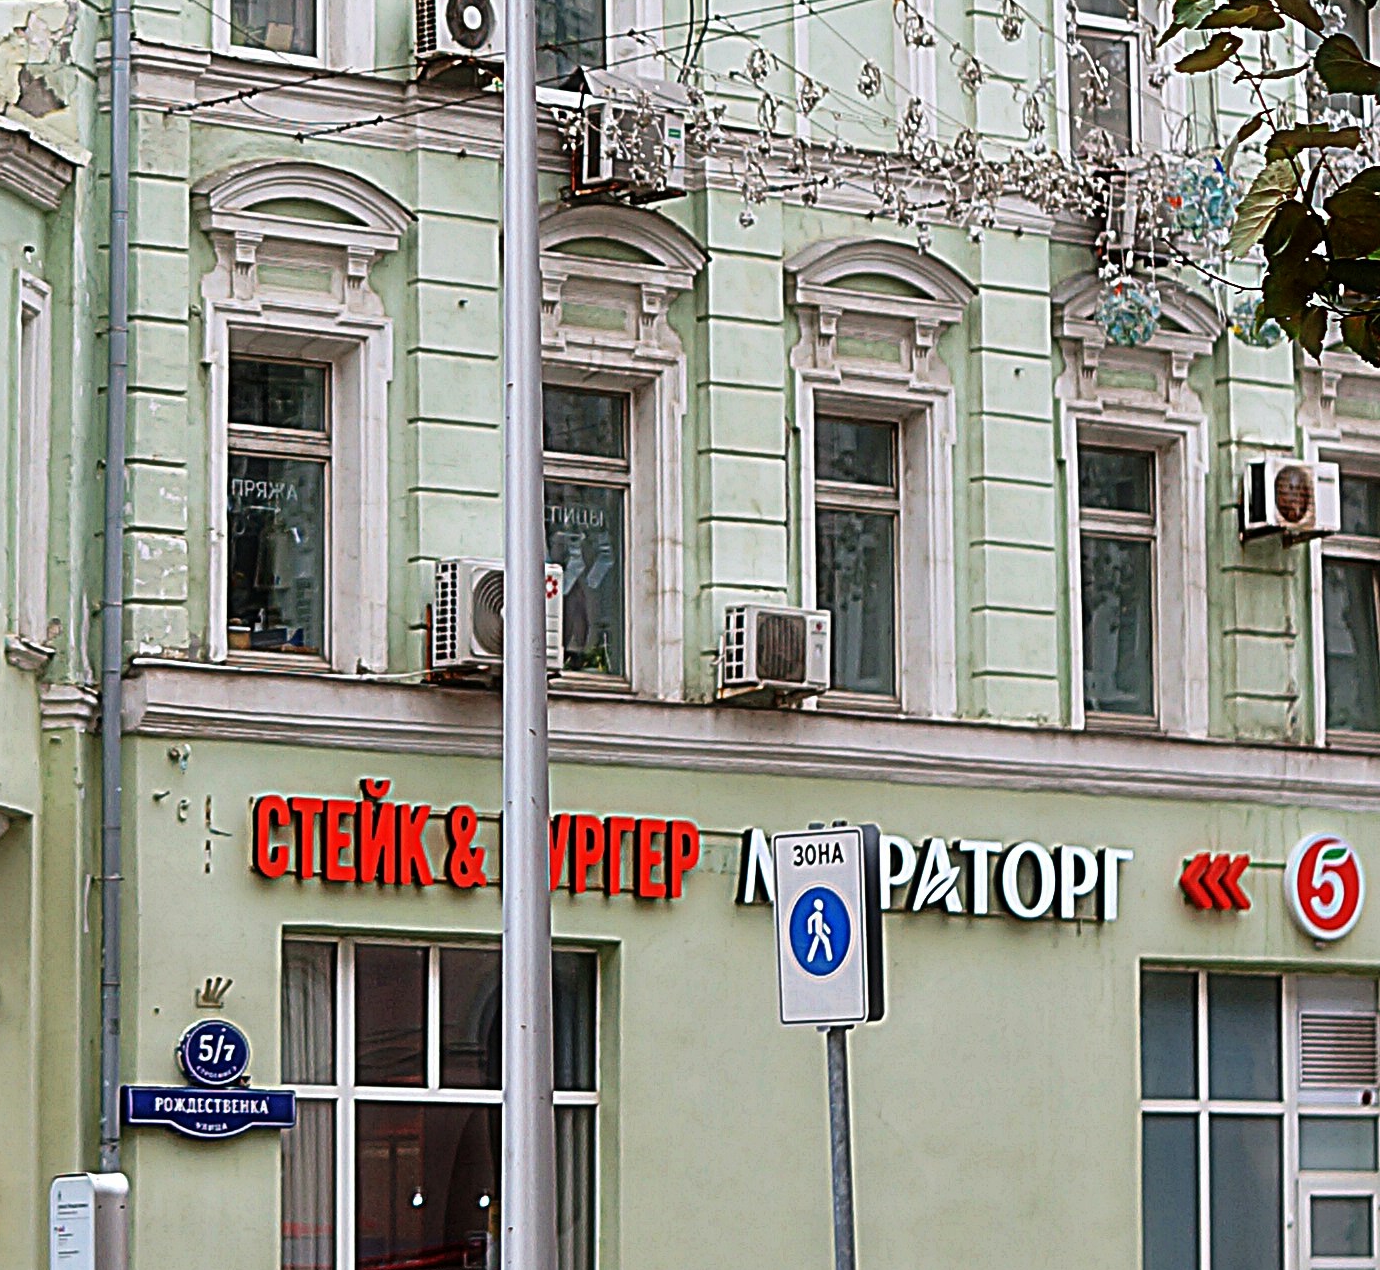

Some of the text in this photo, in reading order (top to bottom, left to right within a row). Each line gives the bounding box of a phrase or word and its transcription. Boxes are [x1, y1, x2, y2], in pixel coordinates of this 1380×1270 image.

[231, 478, 298, 501] ПРЯЖА
[256, 779, 435, 887] СТЕЙК
[448, 806, 488, 888] &
[792, 841, 845, 867] ЗОНА
[198, 1034, 236, 1064] 5/7
[154, 1096, 269, 1114] РОЖДЕСТВЕНКА
